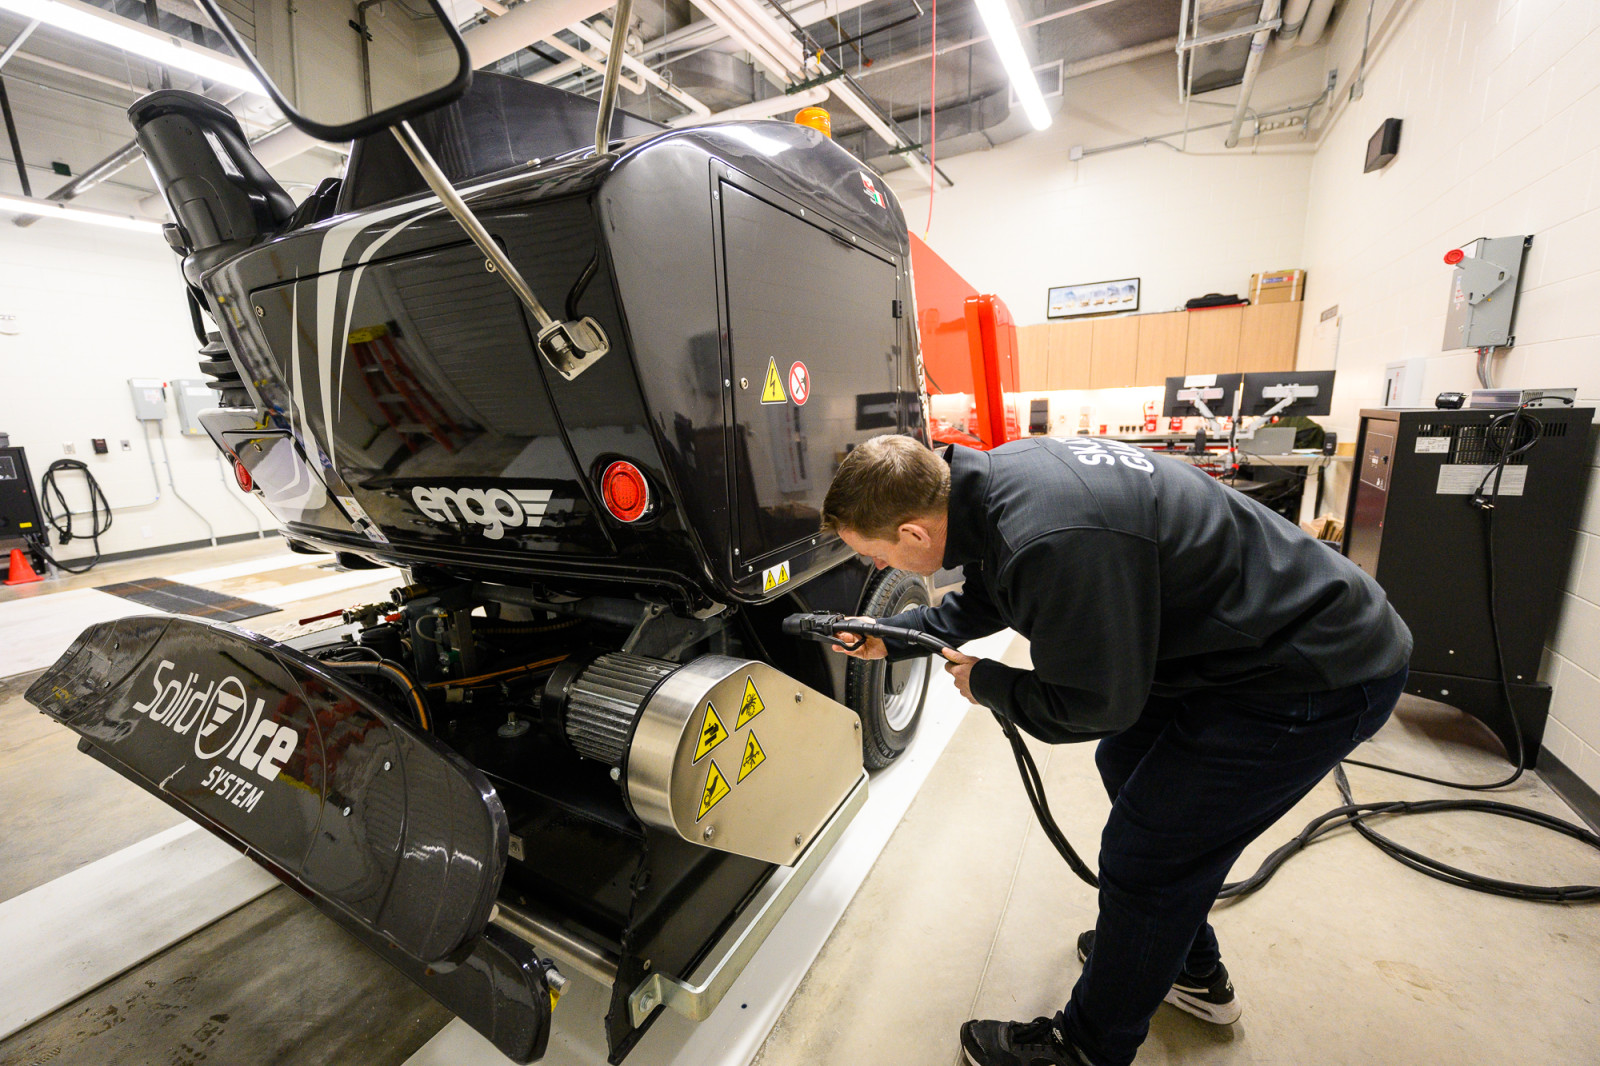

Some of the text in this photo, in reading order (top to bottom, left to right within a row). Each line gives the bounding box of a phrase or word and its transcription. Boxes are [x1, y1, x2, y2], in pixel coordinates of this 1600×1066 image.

[411, 486, 525, 540] engo
[132, 660, 299, 782] Solid Ice
[201, 765, 265, 813] SYSTEM
